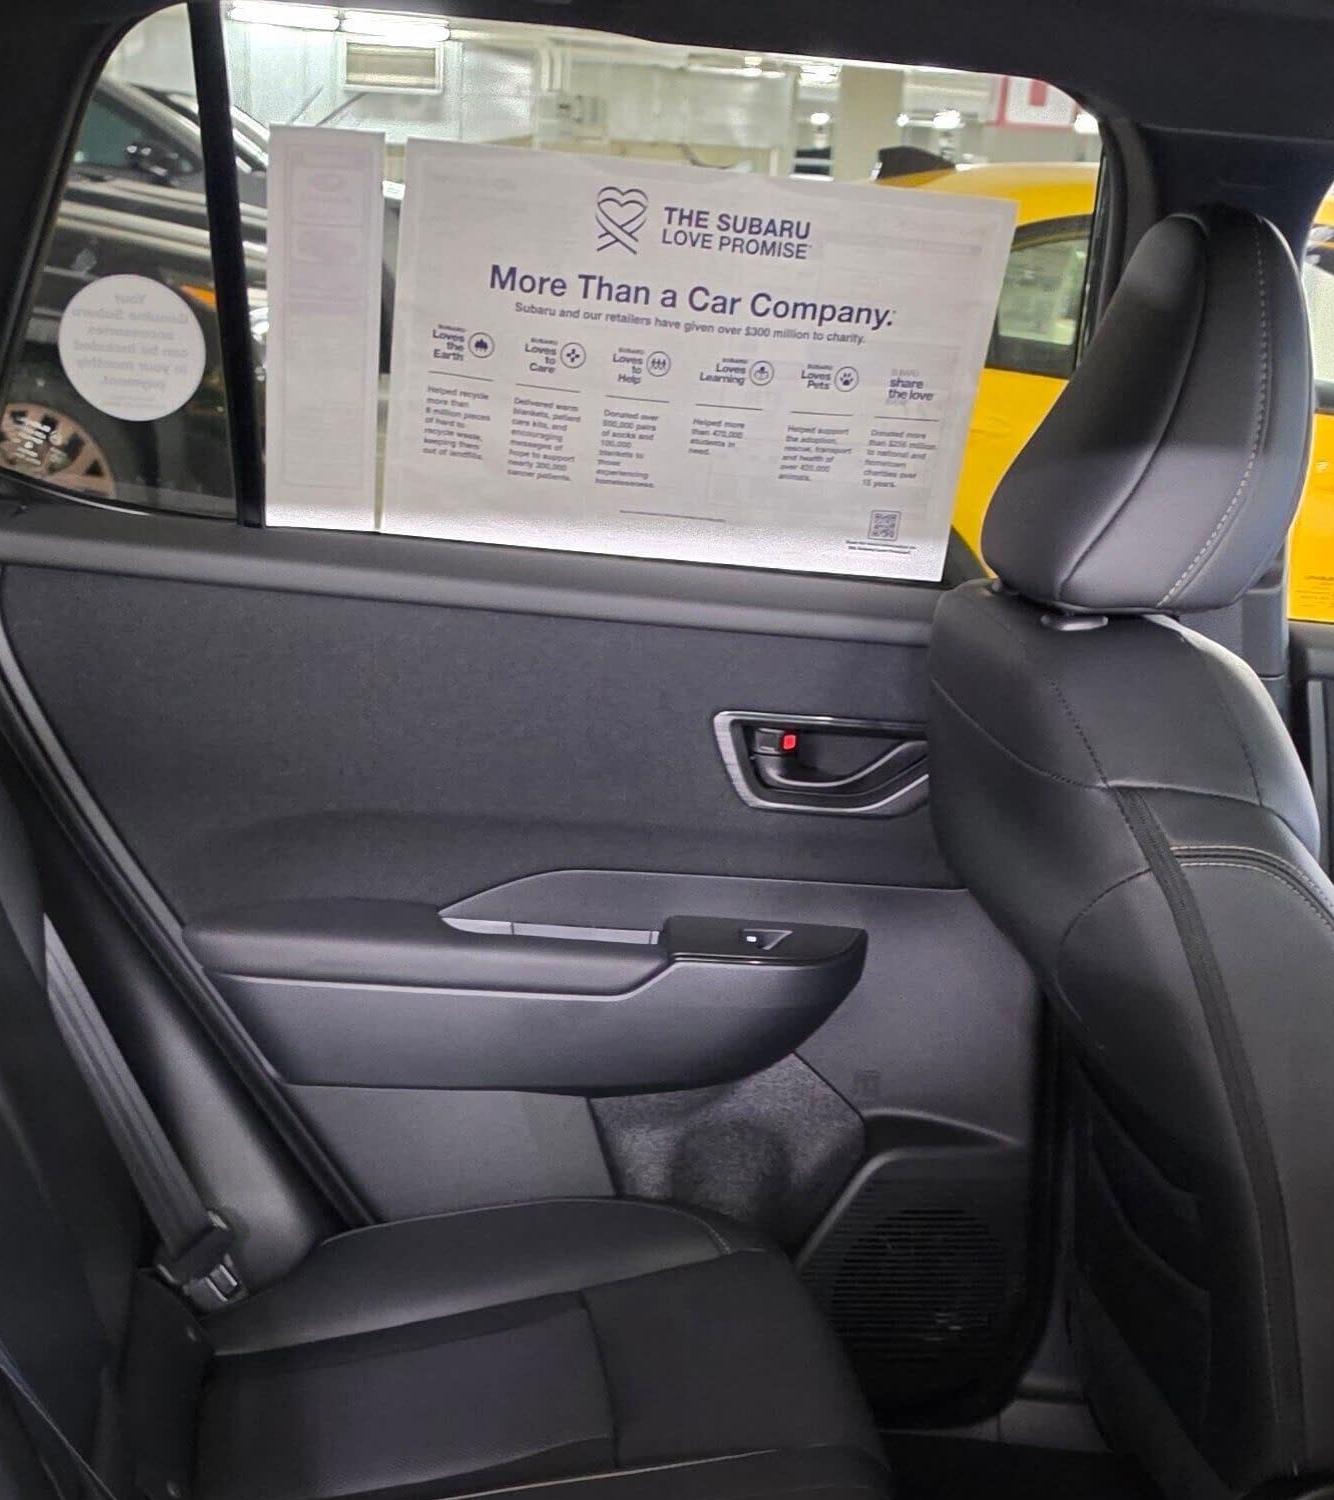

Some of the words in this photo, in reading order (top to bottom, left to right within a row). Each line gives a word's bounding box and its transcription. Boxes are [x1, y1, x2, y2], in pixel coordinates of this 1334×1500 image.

[663, 206, 708, 228] THE
[717, 213, 811, 240] SUBARU
[662, 229, 712, 250] LOVE
[490, 264, 567, 297] More
[578, 274, 650, 305] Than
[661, 288, 676, 308] a
[688, 287, 740, 316] Car
[515, 302, 556, 318] Subaru
[559, 306, 580, 319] and
[583, 311, 602, 321] our
[605, 310, 651, 327] retailers
[655, 316, 681, 330] have
[685, 320, 714, 335] given
[717, 326, 741, 336] over
[744, 326, 770, 339] $300
[773, 327, 811, 341] million
[813, 331, 824, 341] to
[827, 331, 865, 346] charity.
[433, 329, 465, 343] Loves
[446, 342, 464, 351] the
[525, 344, 556, 356] Loves
[433, 349, 464, 362] Earth
[545, 356, 556, 365] to
[613, 353, 643, 365] Loves
[529, 363, 555, 374] Care
[632, 365, 642, 374] to
[716, 363, 746, 375] Loves
[617, 373, 641, 385] Help
[700, 372, 745, 386] Learning
[801, 370, 831, 382] Loves
[807, 380, 829, 391] Pets
[890, 378, 923, 389] share
[887, 389, 908, 400] the
[909, 389, 933, 401] love
